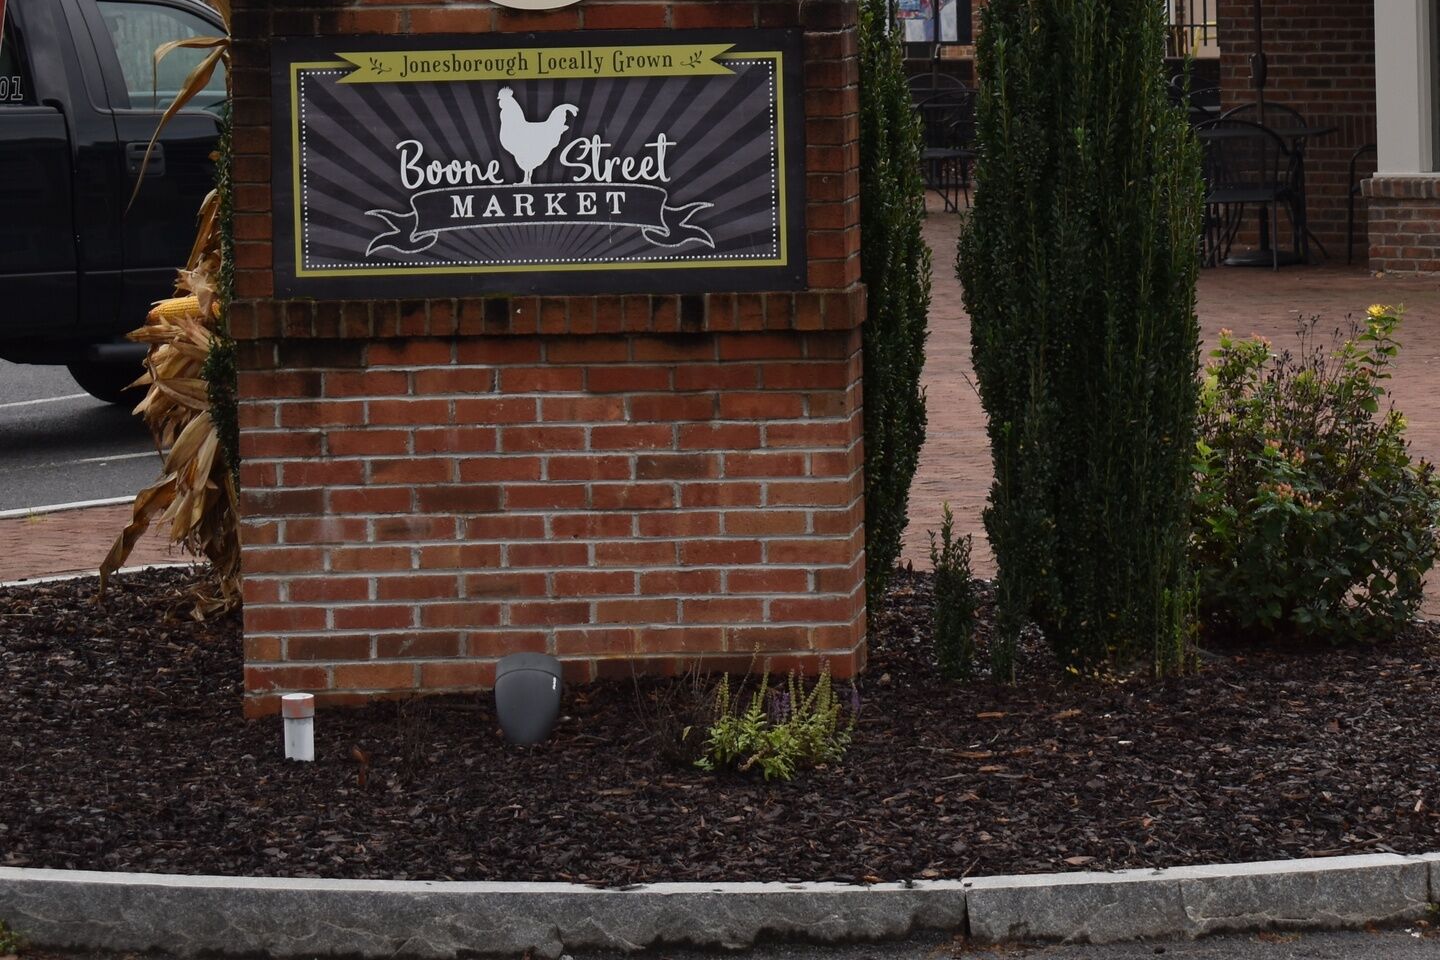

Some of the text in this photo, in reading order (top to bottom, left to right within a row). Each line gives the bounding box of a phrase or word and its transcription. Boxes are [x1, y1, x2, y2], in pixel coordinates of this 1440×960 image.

[399, 49, 674, 78] Jonesborough Locally Grown
[395, 132, 677, 190] Boone Street
[449, 190, 627, 219] MARKET
